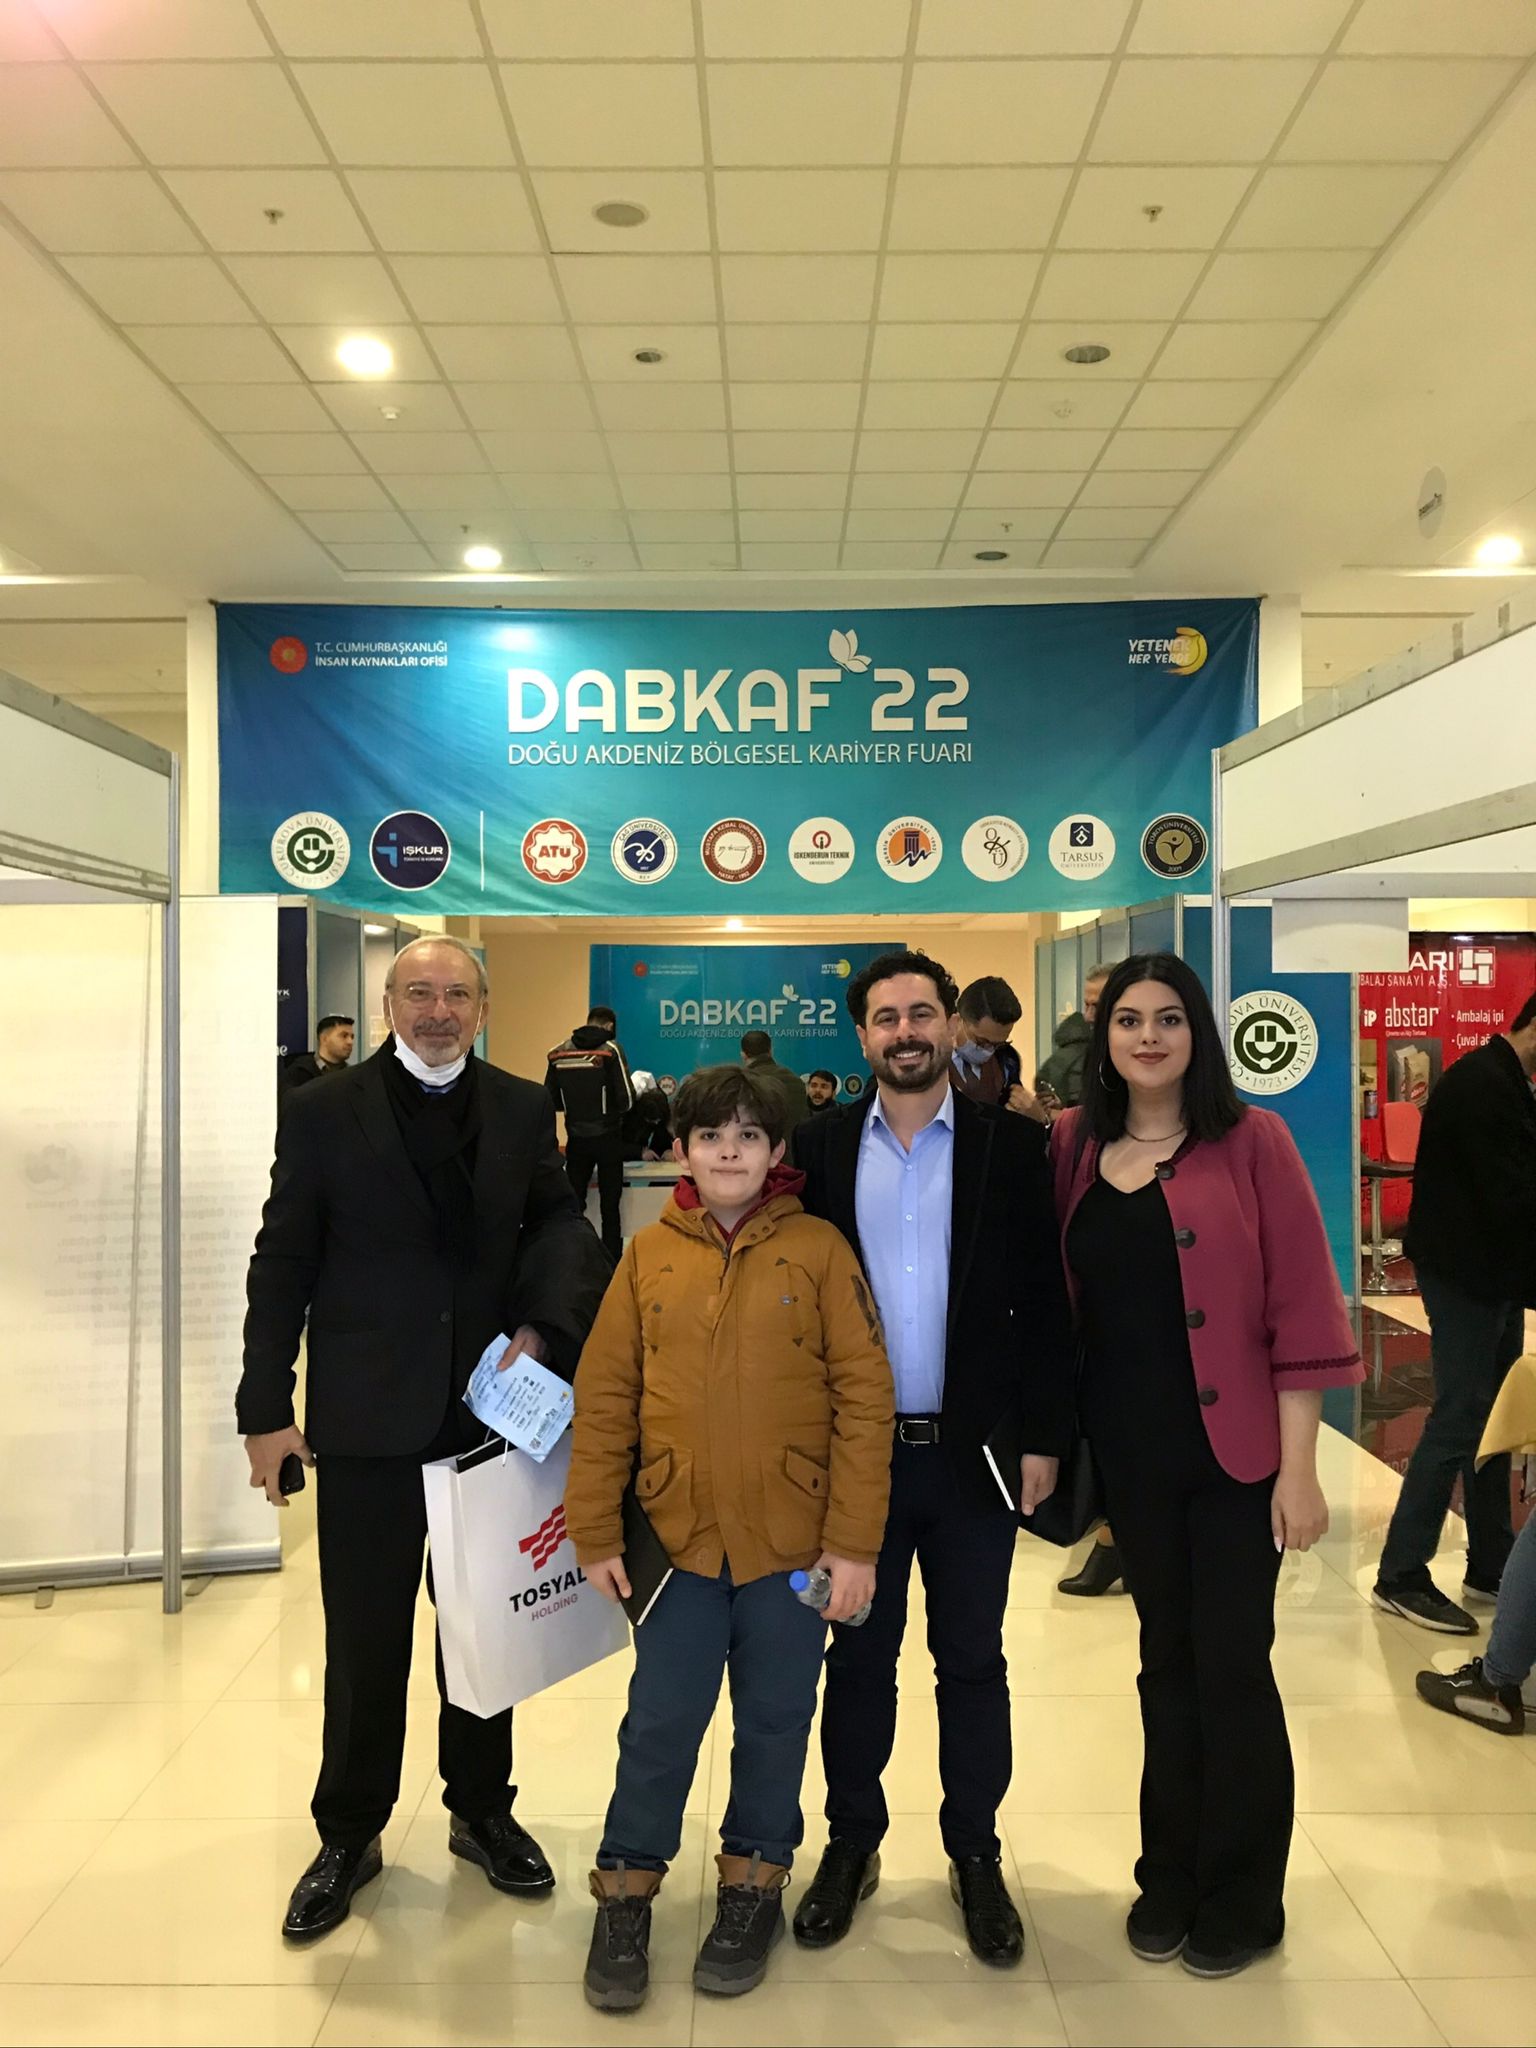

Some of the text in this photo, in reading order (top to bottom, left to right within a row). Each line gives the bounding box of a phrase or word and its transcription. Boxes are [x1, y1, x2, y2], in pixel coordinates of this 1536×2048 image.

[315, 640, 447, 655] T.C. CUMHURBAŞKANLIĞI
[315, 655, 448, 667] İNSAN KAYNAKLARI OFİSİ
[1128, 654, 1151, 664] HER
[507, 669, 842, 733] DABKAF
[508, 740, 972, 765] DOĞU AKDENİZ BÖLGESEL KARİYER FUARI
[1060, 852, 1104, 862] TARSUS
[1387, 973, 1424, 987] SANAYİ
[660, 999, 788, 1026] DABKAF
[1385, 997, 1439, 1028] abstar
[1456, 1009, 1504, 1026] Ambalaj ipi
[813, 1027, 838, 1038] FUARI
[1456, 1033, 1478, 1050] Çuval
[1252, 1077, 1282, 1089] 1973
[509, 1567, 588, 1613] TOSYAL
